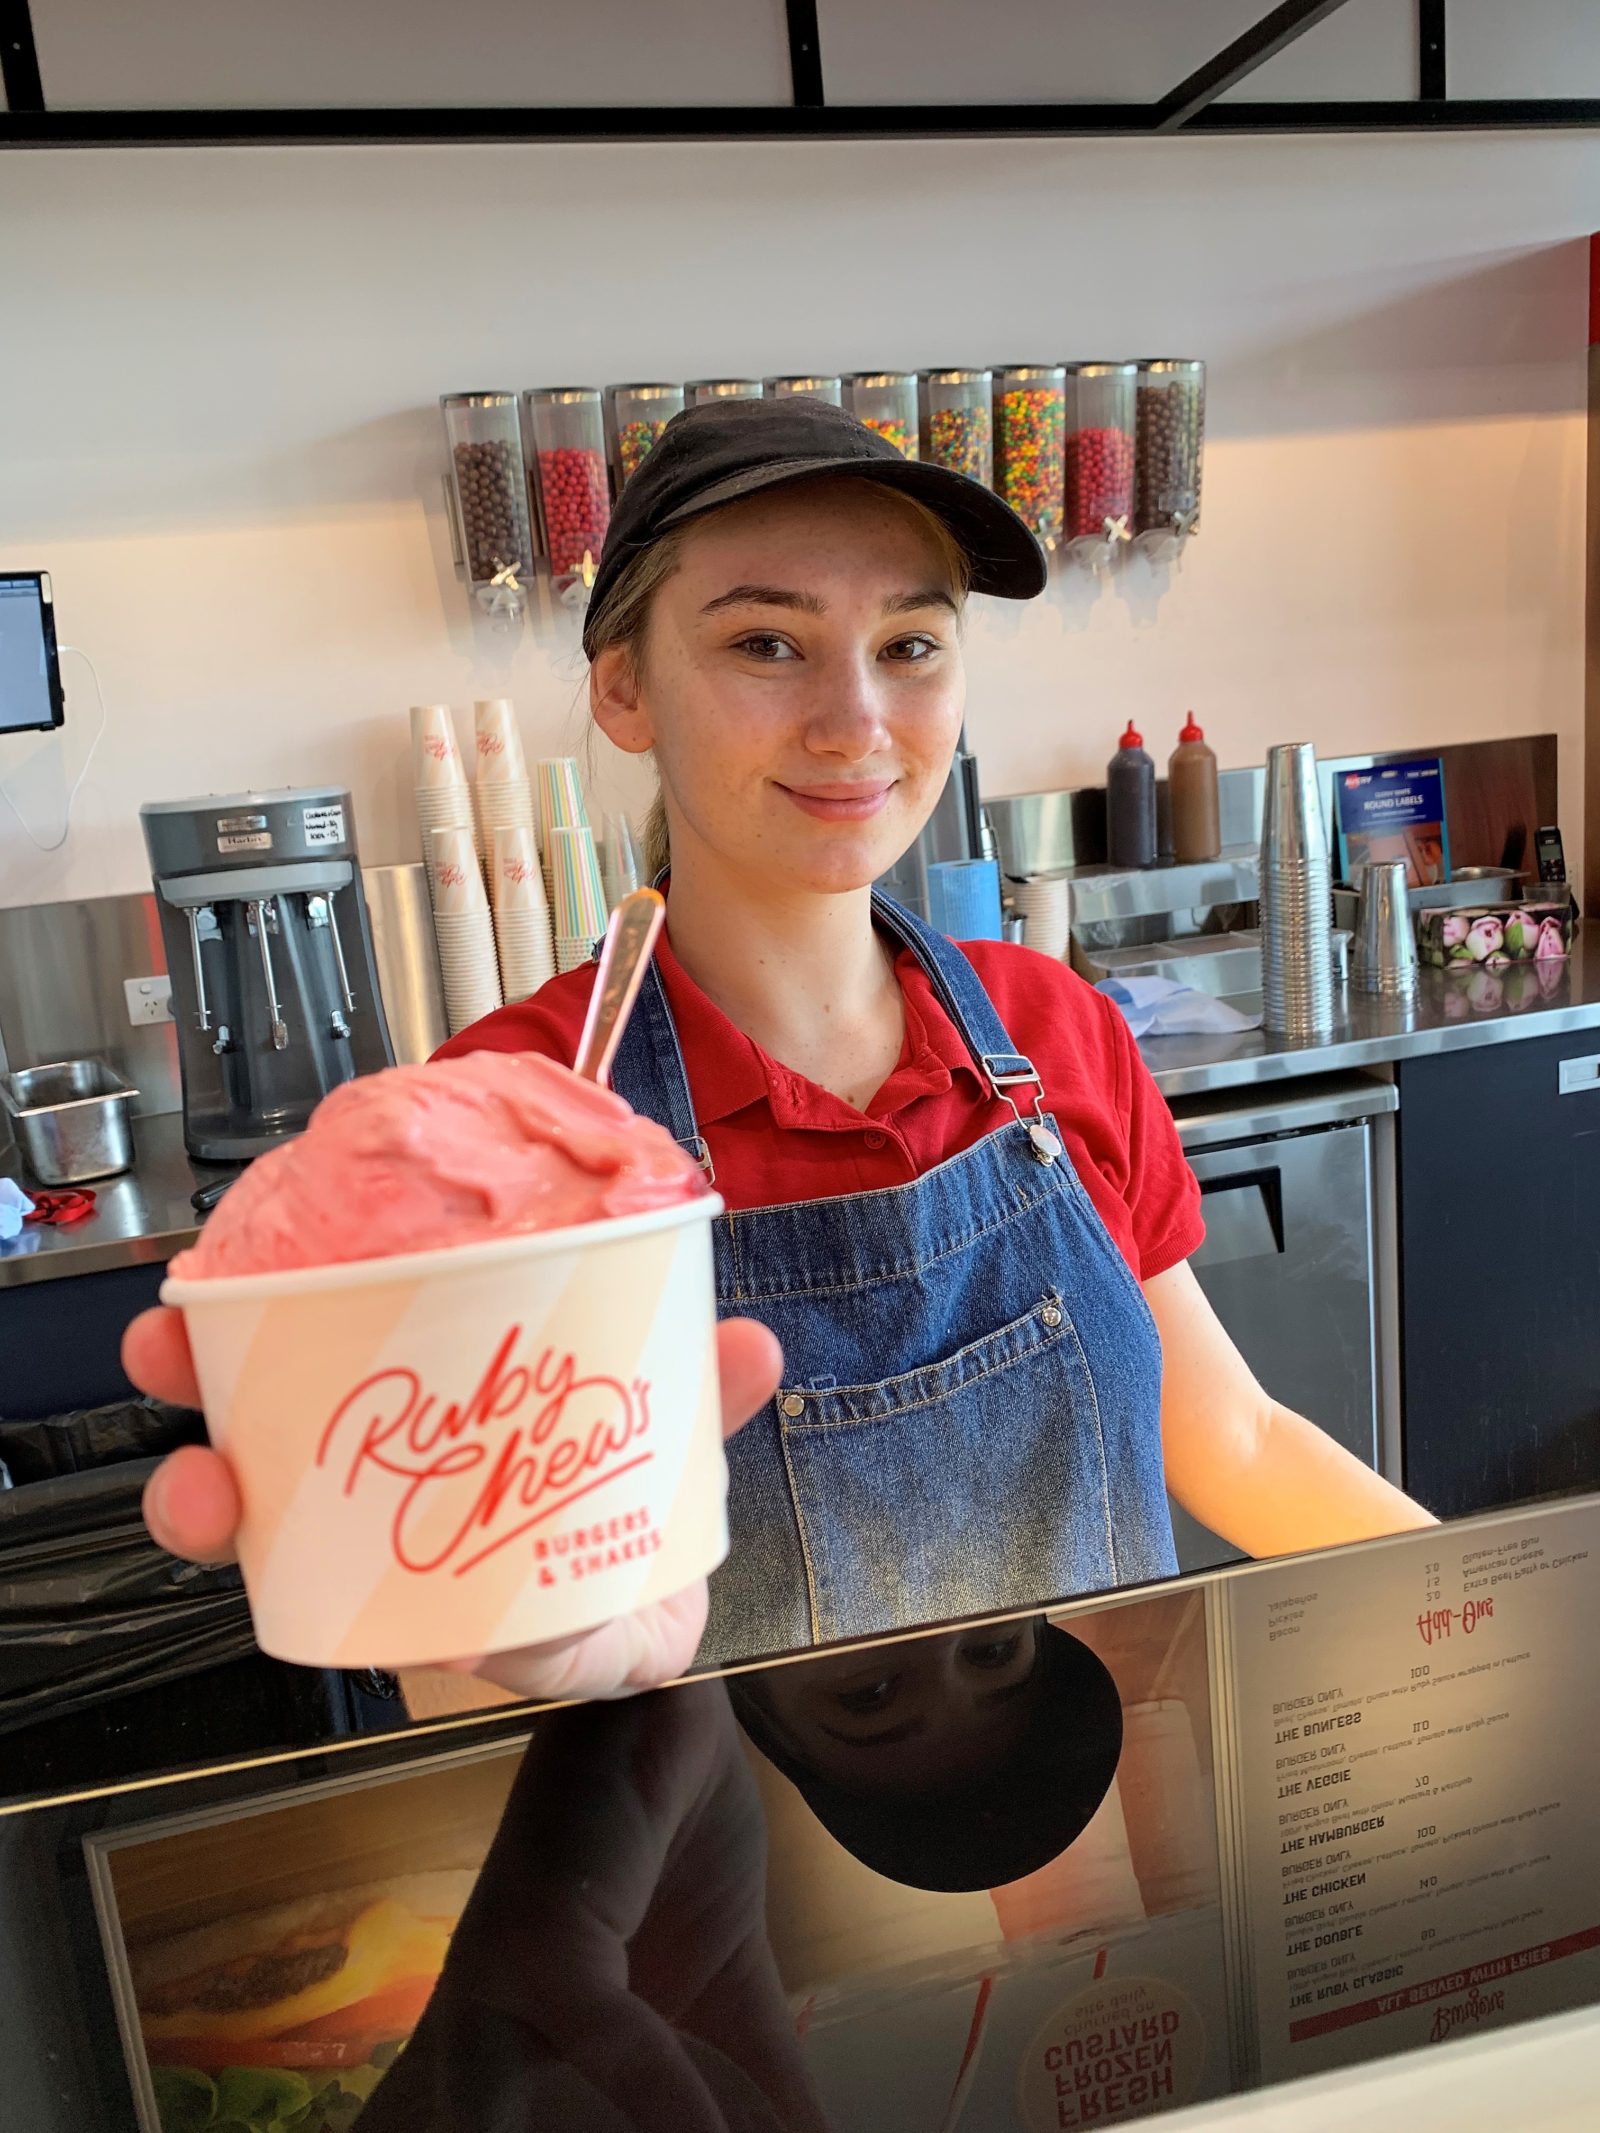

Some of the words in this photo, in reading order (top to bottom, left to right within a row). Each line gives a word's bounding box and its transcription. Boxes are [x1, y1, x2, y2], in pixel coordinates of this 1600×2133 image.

[1363, 799, 1393, 810] ROUND
[1395, 794, 1424, 806] LABELS
[316, 1323, 577, 1497] Ruby
[391, 1375, 653, 1575] Chew's
[533, 1506, 650, 1560] BURGERS
[537, 1565, 556, 1588] &
[570, 1528, 663, 1580] SHAKES
